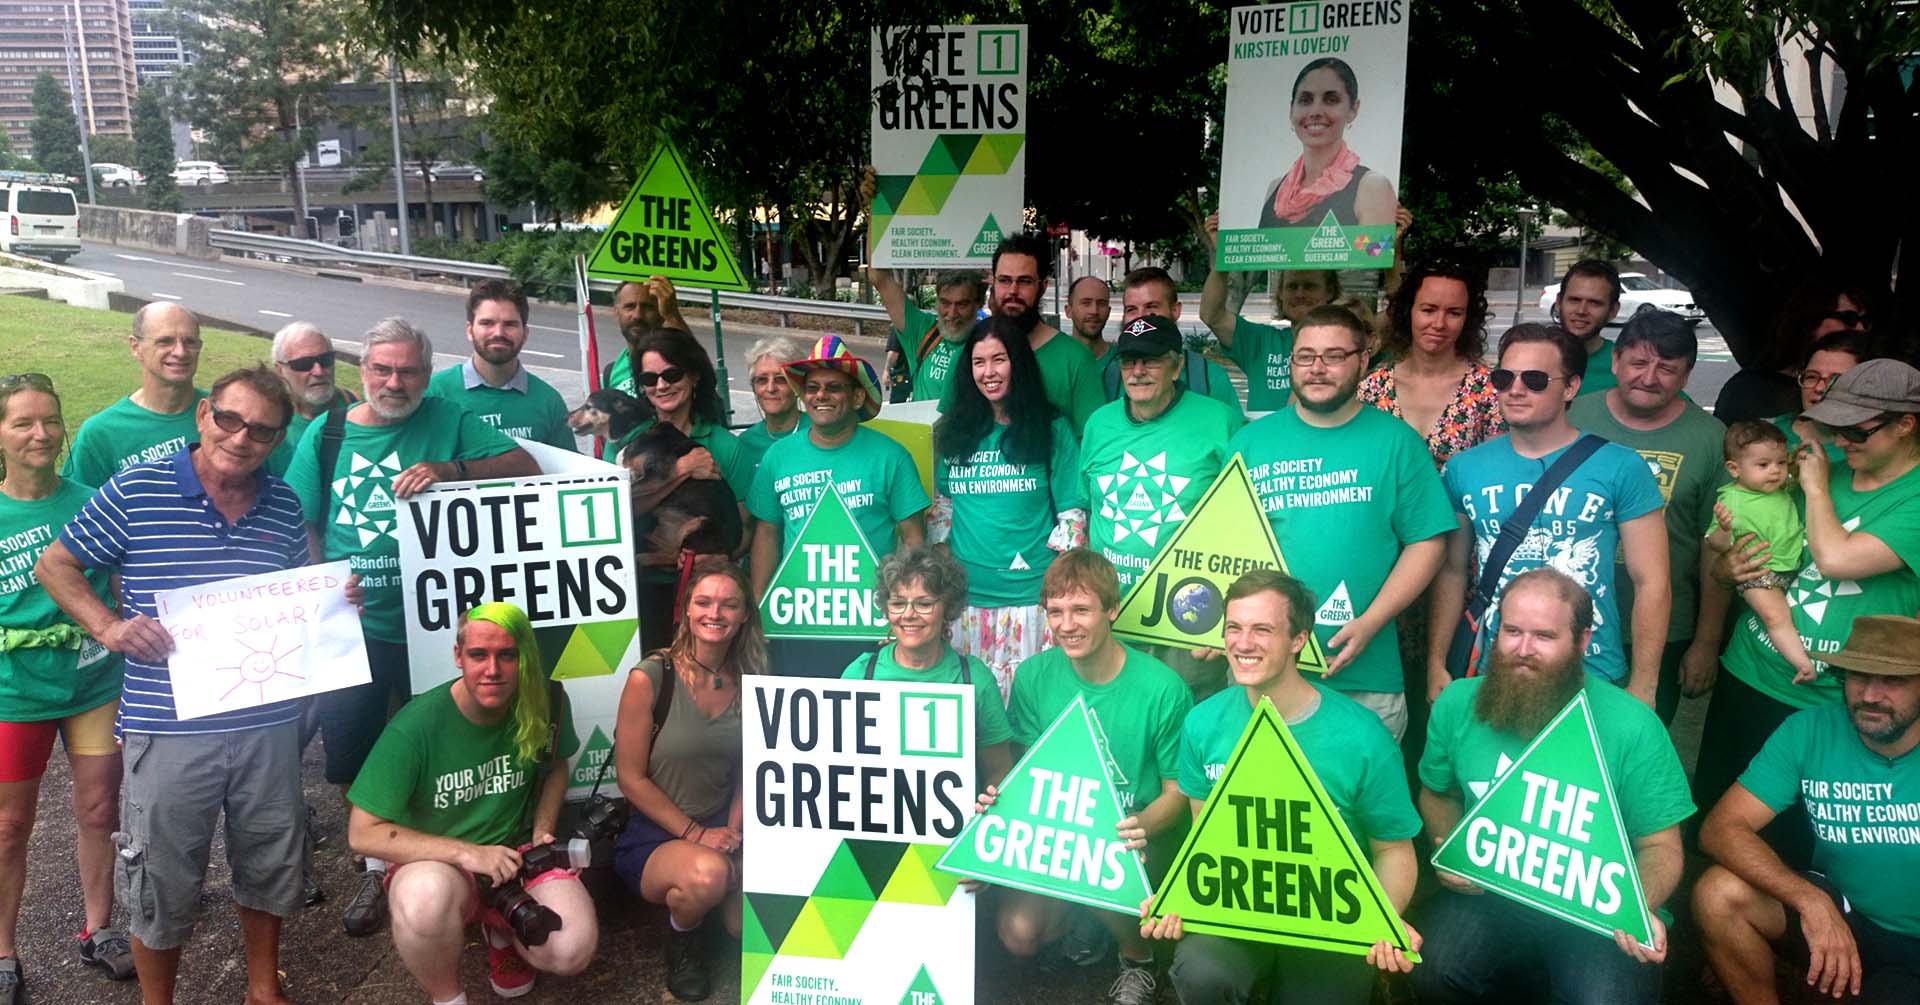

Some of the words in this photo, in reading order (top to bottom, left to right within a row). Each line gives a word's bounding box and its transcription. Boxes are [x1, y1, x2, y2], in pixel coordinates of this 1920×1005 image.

[1238, 8, 1285, 35] VOTE
[1300, 8, 1307, 28] 1
[1323, 0, 1401, 29] GREENS
[993, 36, 1002, 69] 1
[1234, 40, 1289, 59] KIRSTEN
[1293, 35, 1350, 55] LOVEJOY
[880, 83, 1019, 130] GREENS
[640, 195, 691, 231] THE
[892, 228, 906, 236] FAIR
[907, 228, 936, 236] SOCIETY.
[982, 231, 999, 242] THE
[1225, 235, 1239, 243] FAIR
[1240, 234, 1268, 242] SOCIETY.
[1322, 226, 1337, 236] THE
[610, 230, 717, 272] GREENS
[891, 239, 918, 247] HEALTHY
[891, 249, 911, 258] CLEAN
[973, 243, 998, 254] GREE
[1225, 245, 1251, 253] HEALTHY
[1311, 237, 1345, 248] GREENS
[1224, 255, 1243, 264] CLEAN
[1304, 253, 1348, 262] QUEENSLAND
[931, 354, 951, 367] NEE
[930, 366, 947, 380] VOT
[141, 436, 186, 462] SOCIETY
[775, 477, 791, 492] FAIR
[793, 469, 832, 487] SOCIETY
[949, 466, 977, 479] ALTHY
[1248, 464, 1270, 481] FAIR
[1273, 458, 1323, 474] SOCIETY
[949, 481, 967, 494] EAN
[969, 478, 1037, 494] ENVIRONMENT
[1254, 476, 1296, 496] EALTHY
[1299, 469, 1358, 489] ECONOMY
[781, 487, 812, 506] ALTHY
[1262, 494, 1285, 512] EAN
[1288, 486, 1373, 508] ENVIRONMENT
[409, 494, 543, 559] VOTE
[581, 496, 596, 538] 1
[1552, 520, 1576, 536] 85
[0, 524, 52, 554] SOCIETY
[802, 544, 860, 582] THE
[1174, 548, 1204, 570] THE
[192, 576, 339, 608] VOLUNTEERED
[416, 555, 627, 631] GREENS
[1320, 609, 1352, 621] GREENS
[1332, 599, 1346, 609] THE
[169, 624, 208, 640] FOR
[1817, 639, 1841, 655] up
[755, 687, 881, 755] VOTE
[923, 701, 936, 748] 1
[436, 769, 474, 793] YOUR
[477, 755, 513, 780] VOTE
[434, 792, 448, 809] IS
[756, 760, 964, 838] GREENS
[1029, 767, 1101, 828] THE
[1801, 779, 1829, 799] FAIR
[1833, 781, 1892, 801] SOCIETY
[1521, 770, 1600, 844] THE
[1866, 803, 1920, 822] ECONO
[1228, 794, 1313, 855] THE
[1814, 820, 1848, 843] EAN
[1851, 826, 1920, 844] ENVIRON
[975, 814, 1127, 890] GREENS
[1466, 816, 1626, 915] GREENS
[1187, 852, 1361, 925] GREENS
[771, 974, 793, 987] FAIR
[795, 976, 839, 992] SOCIETY.
[771, 991, 812, 1005] HEALTHY
[910, 991, 935, 1005] THE
